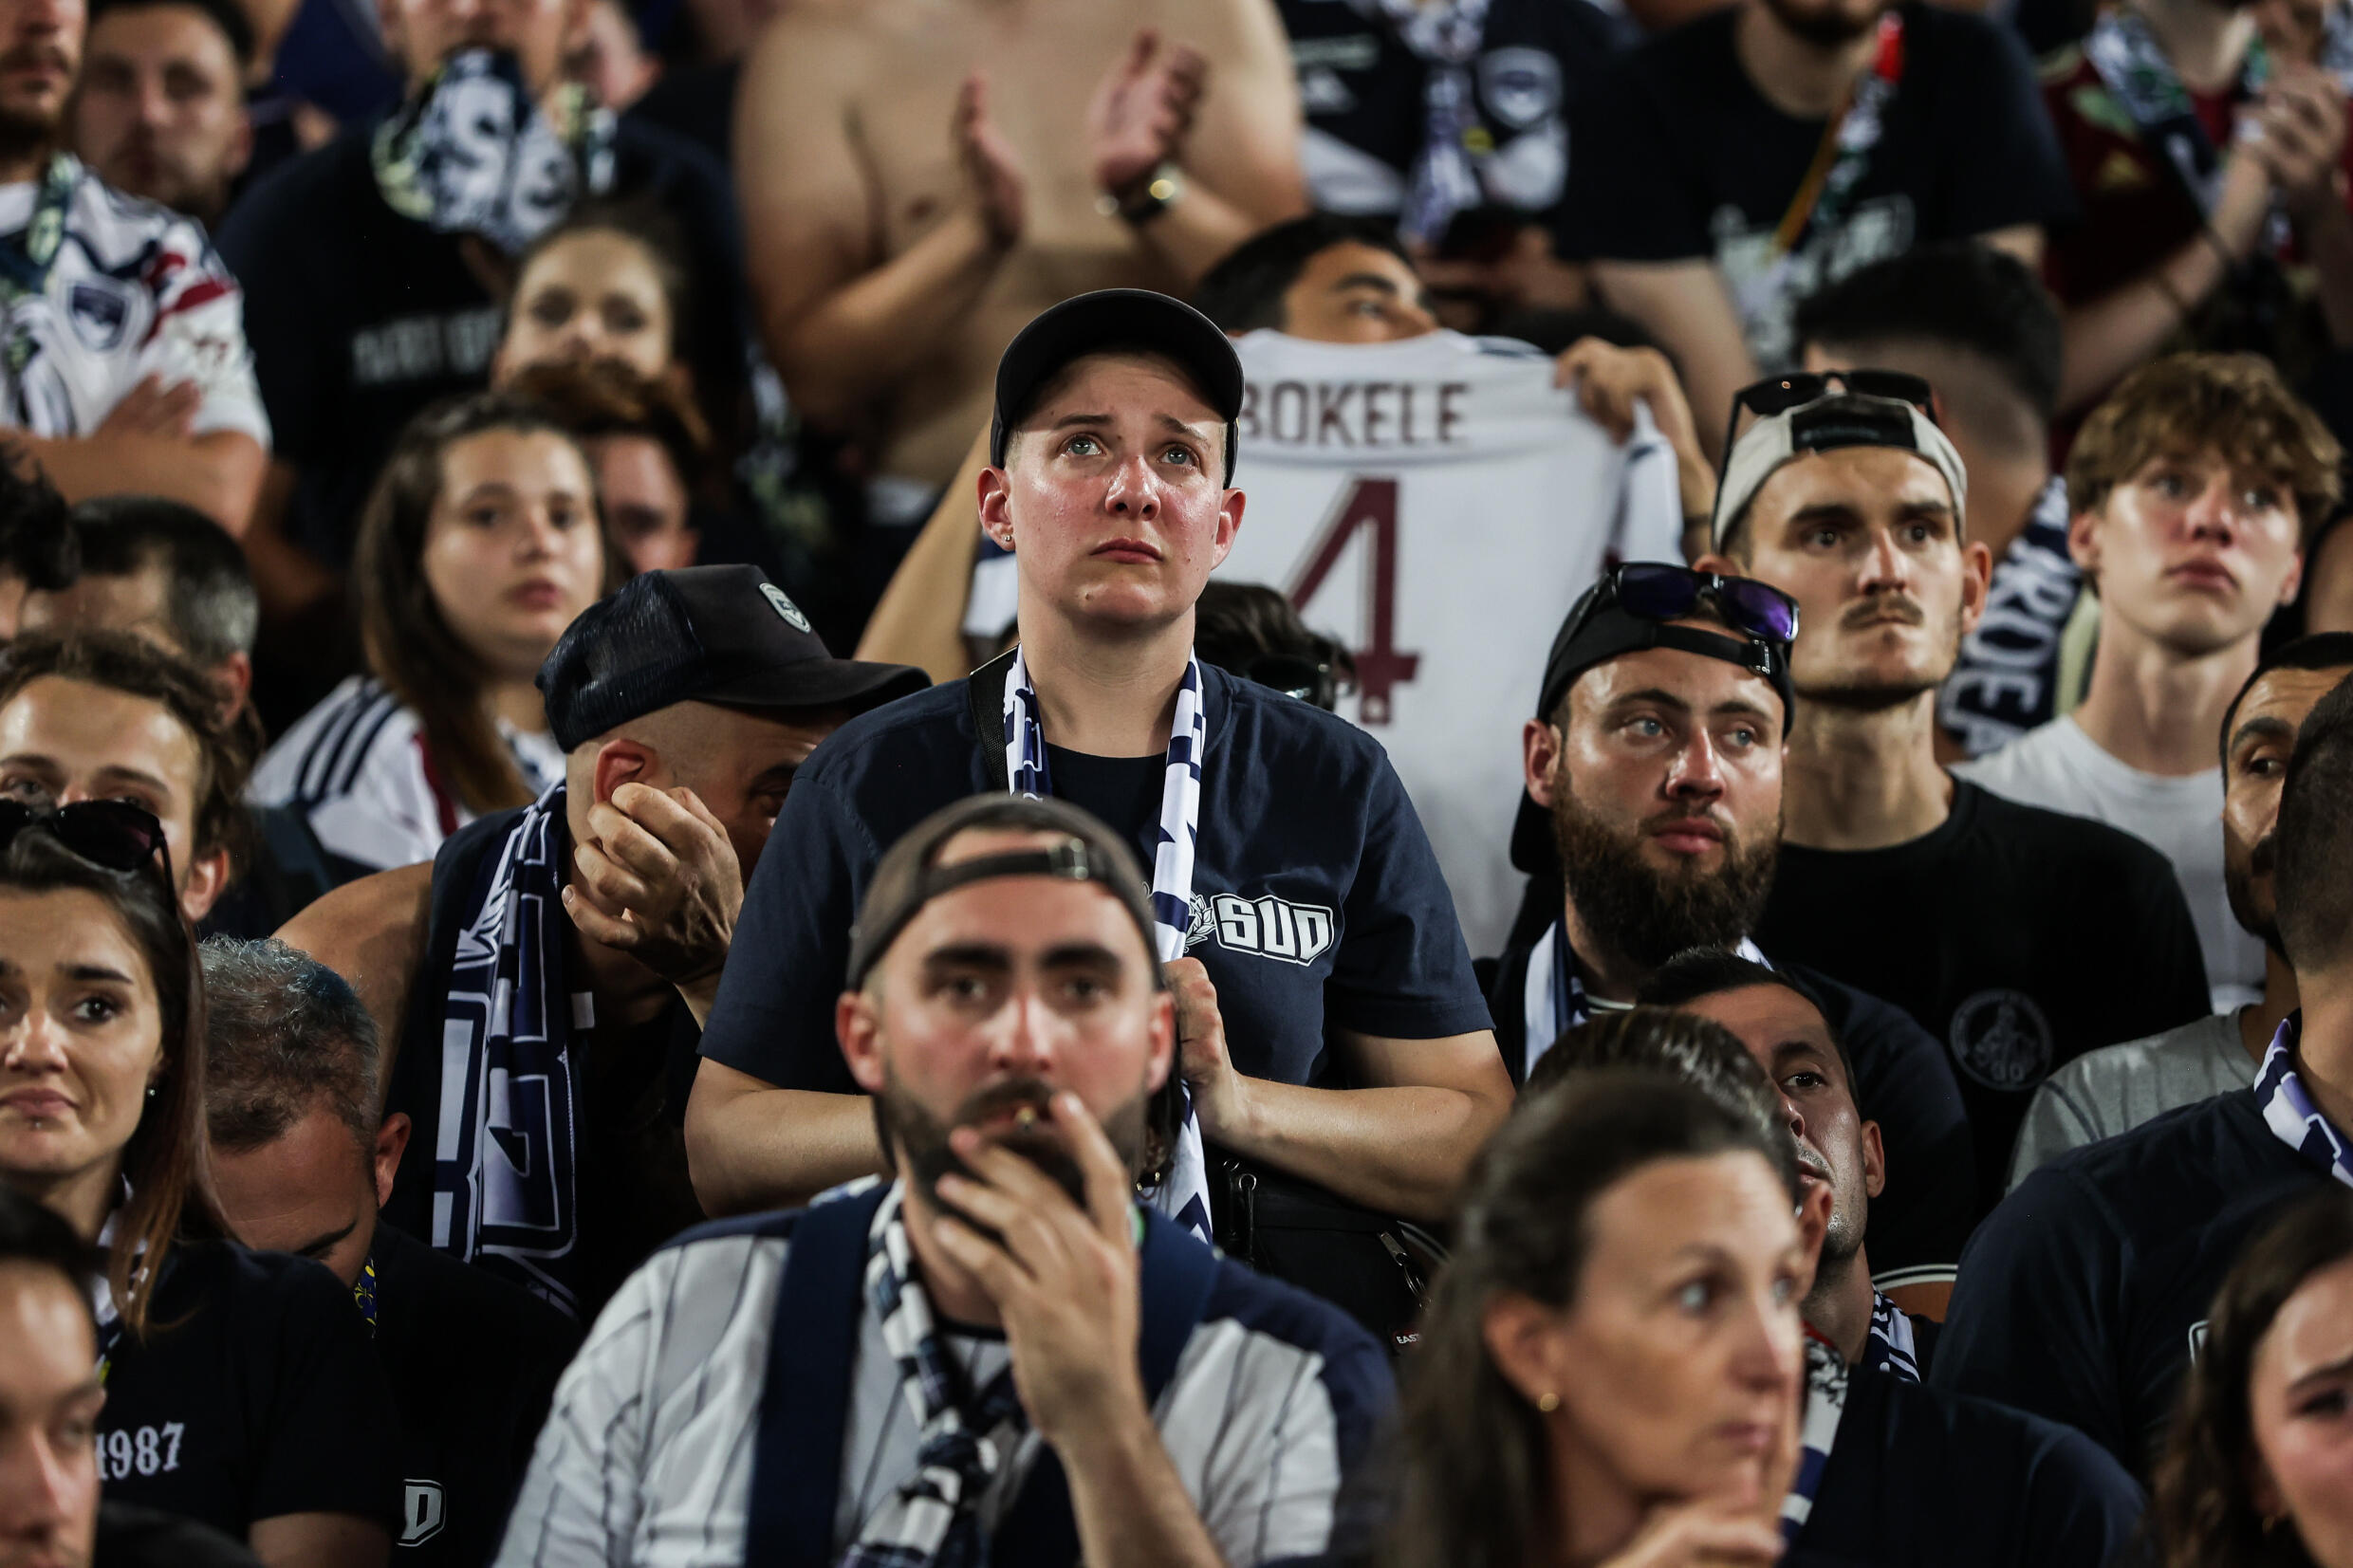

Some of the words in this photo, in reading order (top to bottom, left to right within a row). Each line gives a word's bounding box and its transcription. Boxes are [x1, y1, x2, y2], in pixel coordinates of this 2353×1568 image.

[1284, 477, 1421, 725] 4
[1215, 896, 1331, 962] SUD
[95, 1421, 185, 1481] 1987
